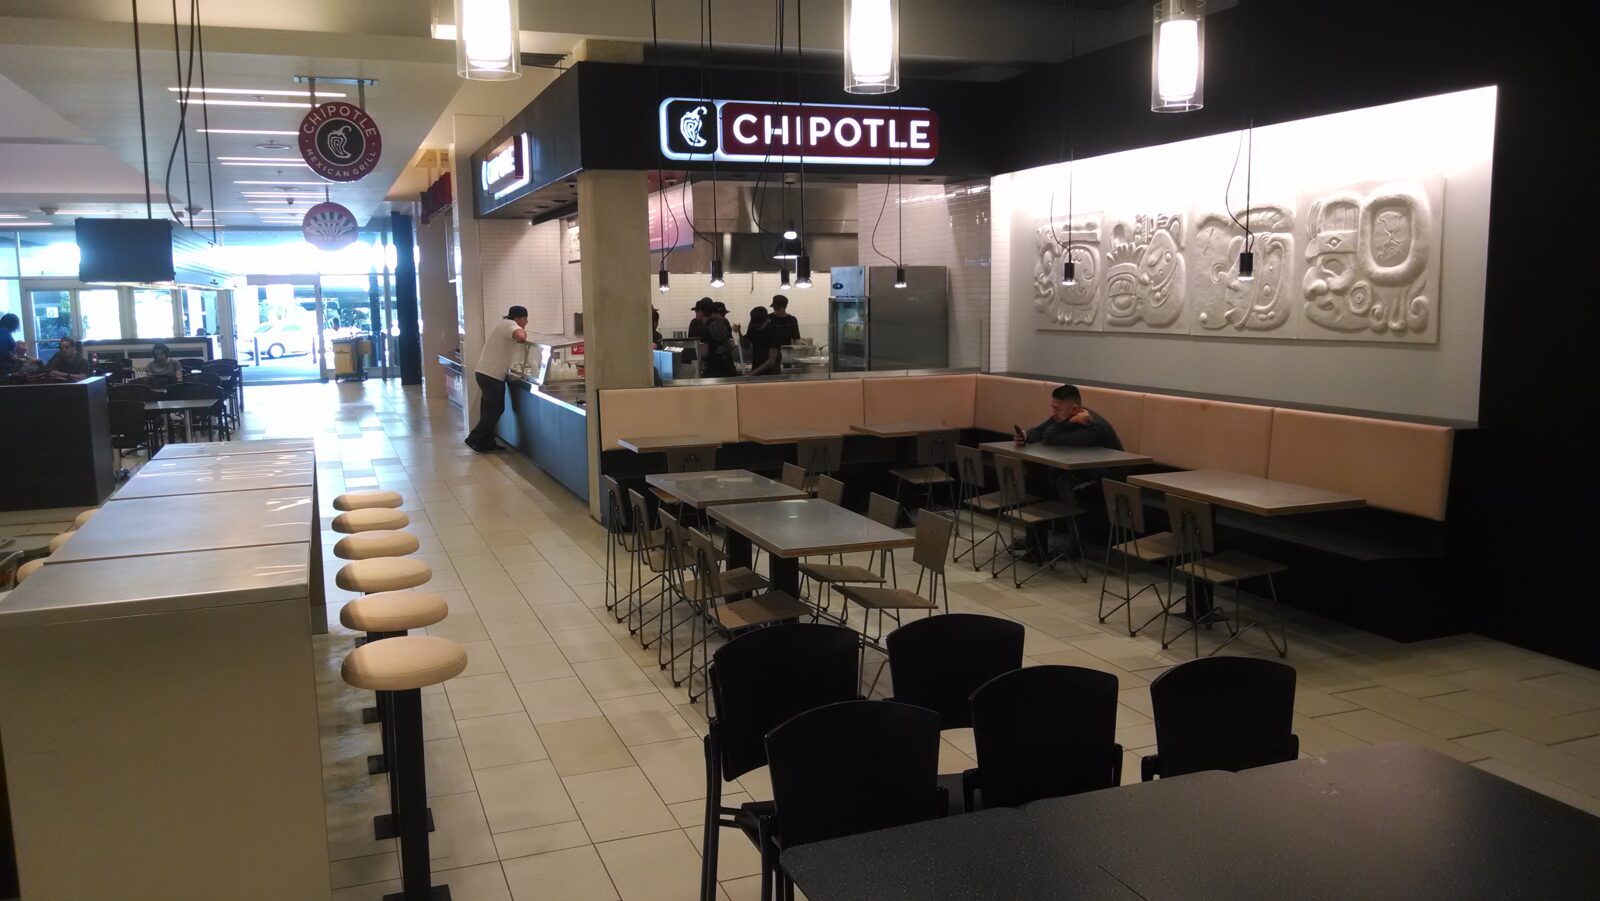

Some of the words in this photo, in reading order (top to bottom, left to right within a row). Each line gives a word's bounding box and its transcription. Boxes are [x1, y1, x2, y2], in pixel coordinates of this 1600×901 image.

[303, 105, 377, 137] CHIPOTLE
[733, 113, 931, 149] CHIPOTLE
[306, 148, 350, 177] MEXICAN
[352, 151, 376, 175] GRILL
